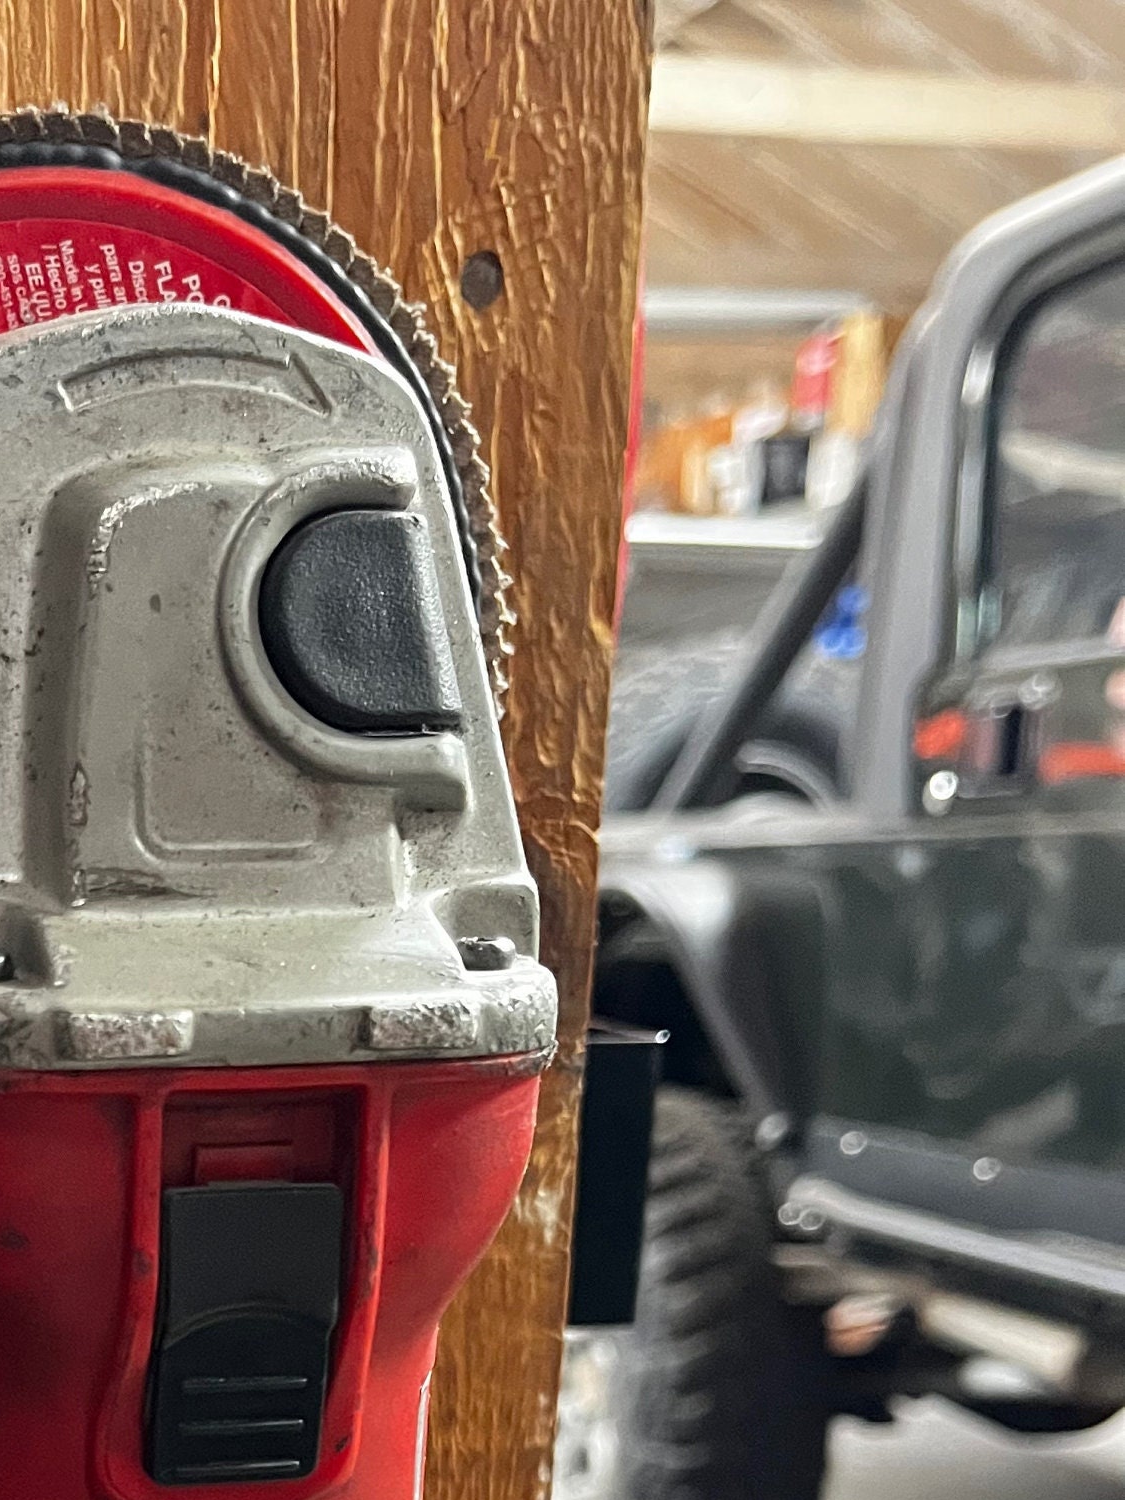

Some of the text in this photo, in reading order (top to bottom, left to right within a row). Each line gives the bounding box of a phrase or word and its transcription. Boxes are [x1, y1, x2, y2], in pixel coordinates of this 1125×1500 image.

[45, 255, 69, 309] Hecho
[59, 239, 81, 283] Made
[70, 285, 85, 301] in
[85, 263, 100, 273] y
[100, 244, 121, 282] para
[154, 260, 177, 301] FLA
